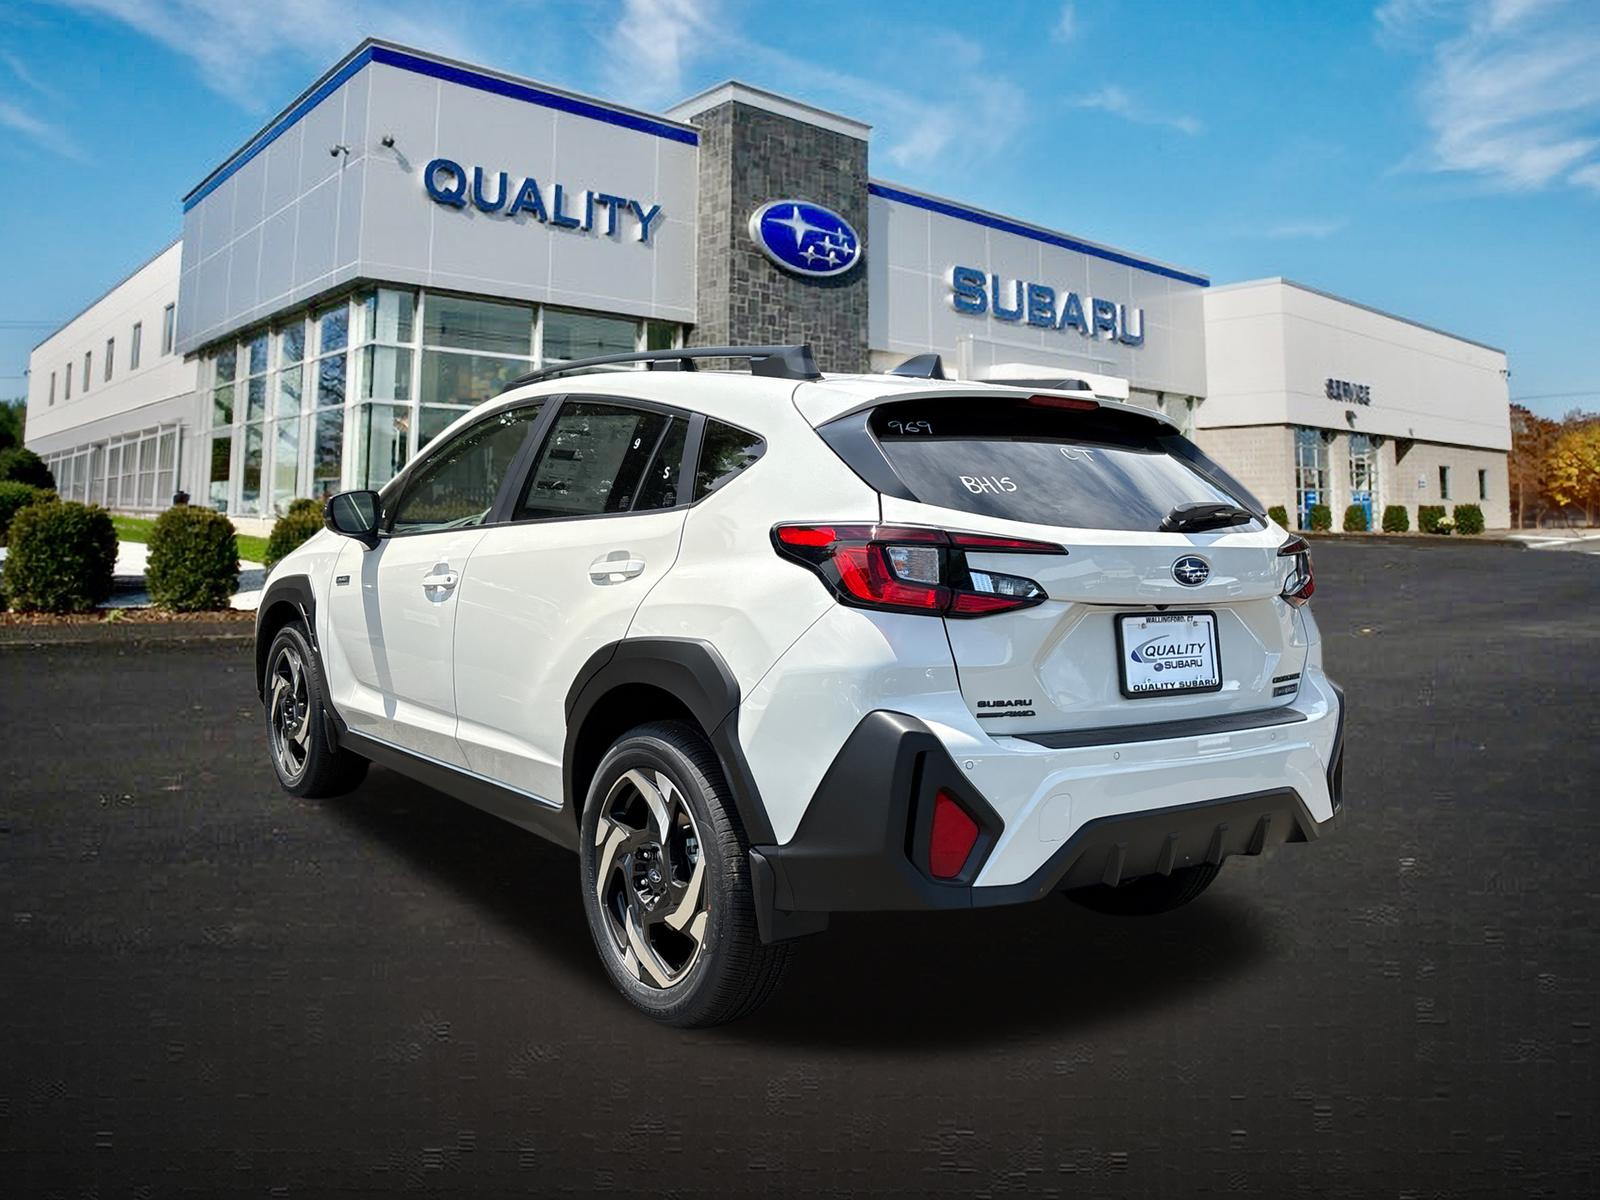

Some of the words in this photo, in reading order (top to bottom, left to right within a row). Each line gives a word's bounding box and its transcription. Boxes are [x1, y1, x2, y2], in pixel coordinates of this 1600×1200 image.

[423, 157, 661, 243] QUALITY
[950, 264, 1145, 347] SUBARU
[1325, 378, 1371, 407] SERVICE
[887, 420, 933, 435] 969
[1145, 642, 1206, 657] QUALITY
[1164, 658, 1203, 670] SUBARU
[1133, 682, 1175, 691] QUALITY
[1179, 679, 1217, 688] SUBARU
[977, 699, 1033, 708] SUBARU
